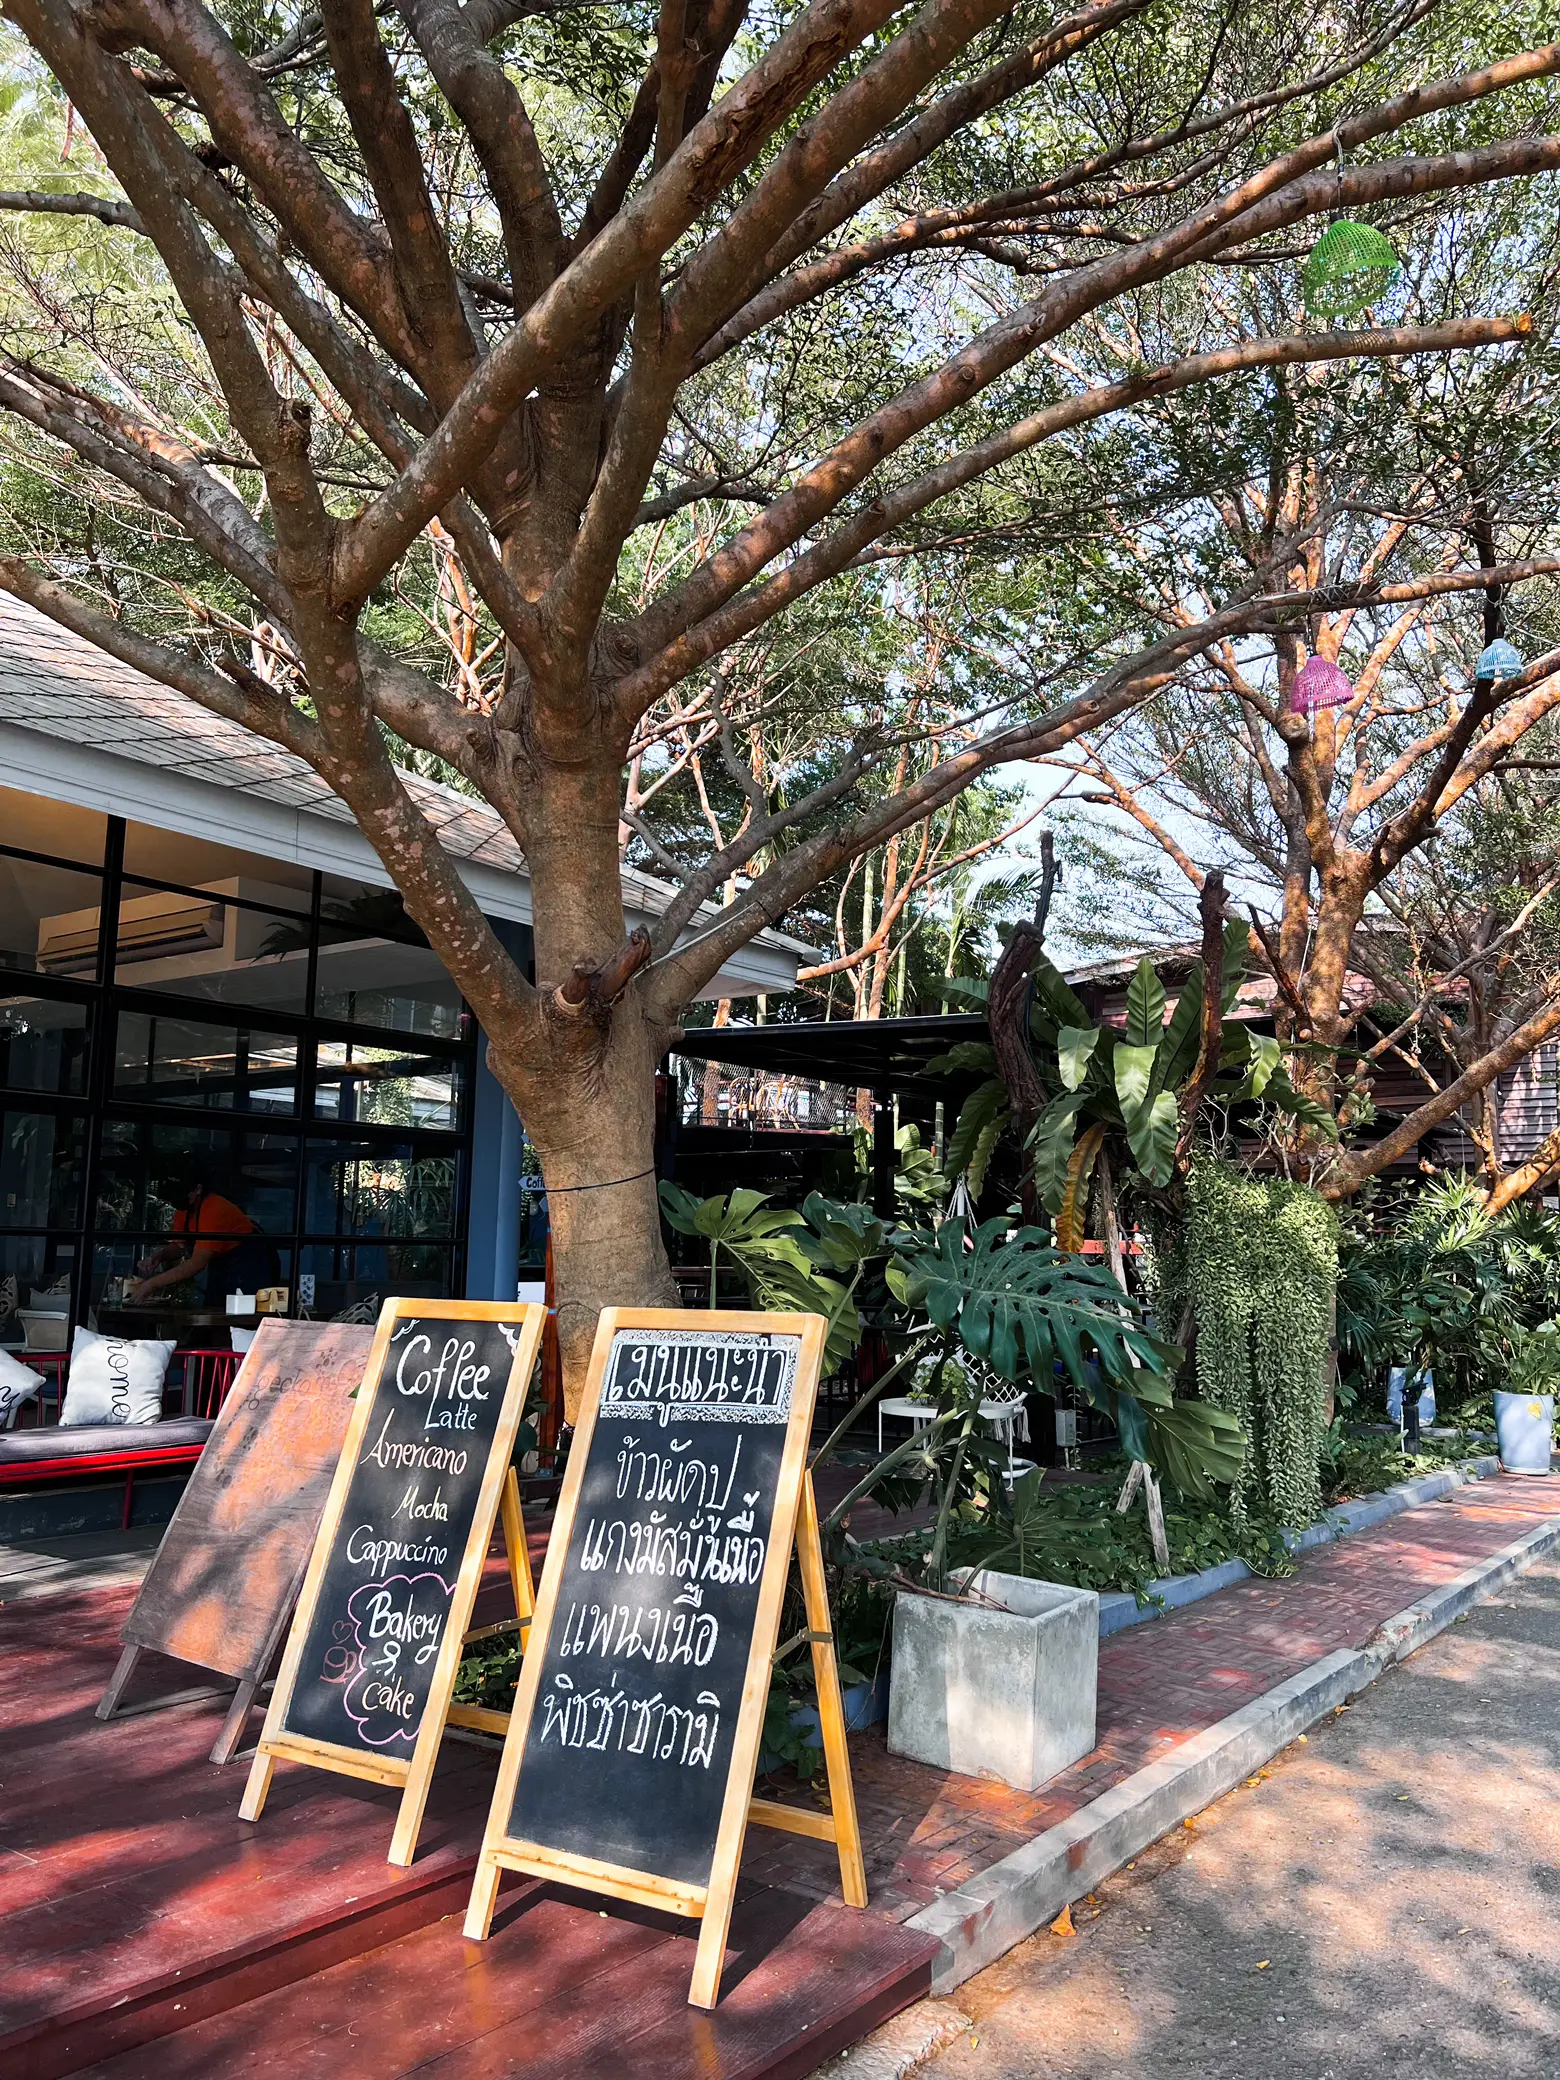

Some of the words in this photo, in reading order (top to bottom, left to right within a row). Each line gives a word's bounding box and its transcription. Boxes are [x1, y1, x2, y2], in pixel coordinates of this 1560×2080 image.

[526, 1177, 546, 1189] Coff
[396, 1334, 490, 1401] Coffee
[609, 1337, 786, 1427] เมนูแนะนำ
[360, 1408, 467, 1475] Americano
[424, 1401, 478, 1430] Latte
[391, 1486, 449, 1522] Mocha
[346, 1525, 448, 1577] Cappuccino
[366, 1590, 443, 1665] Bakery
